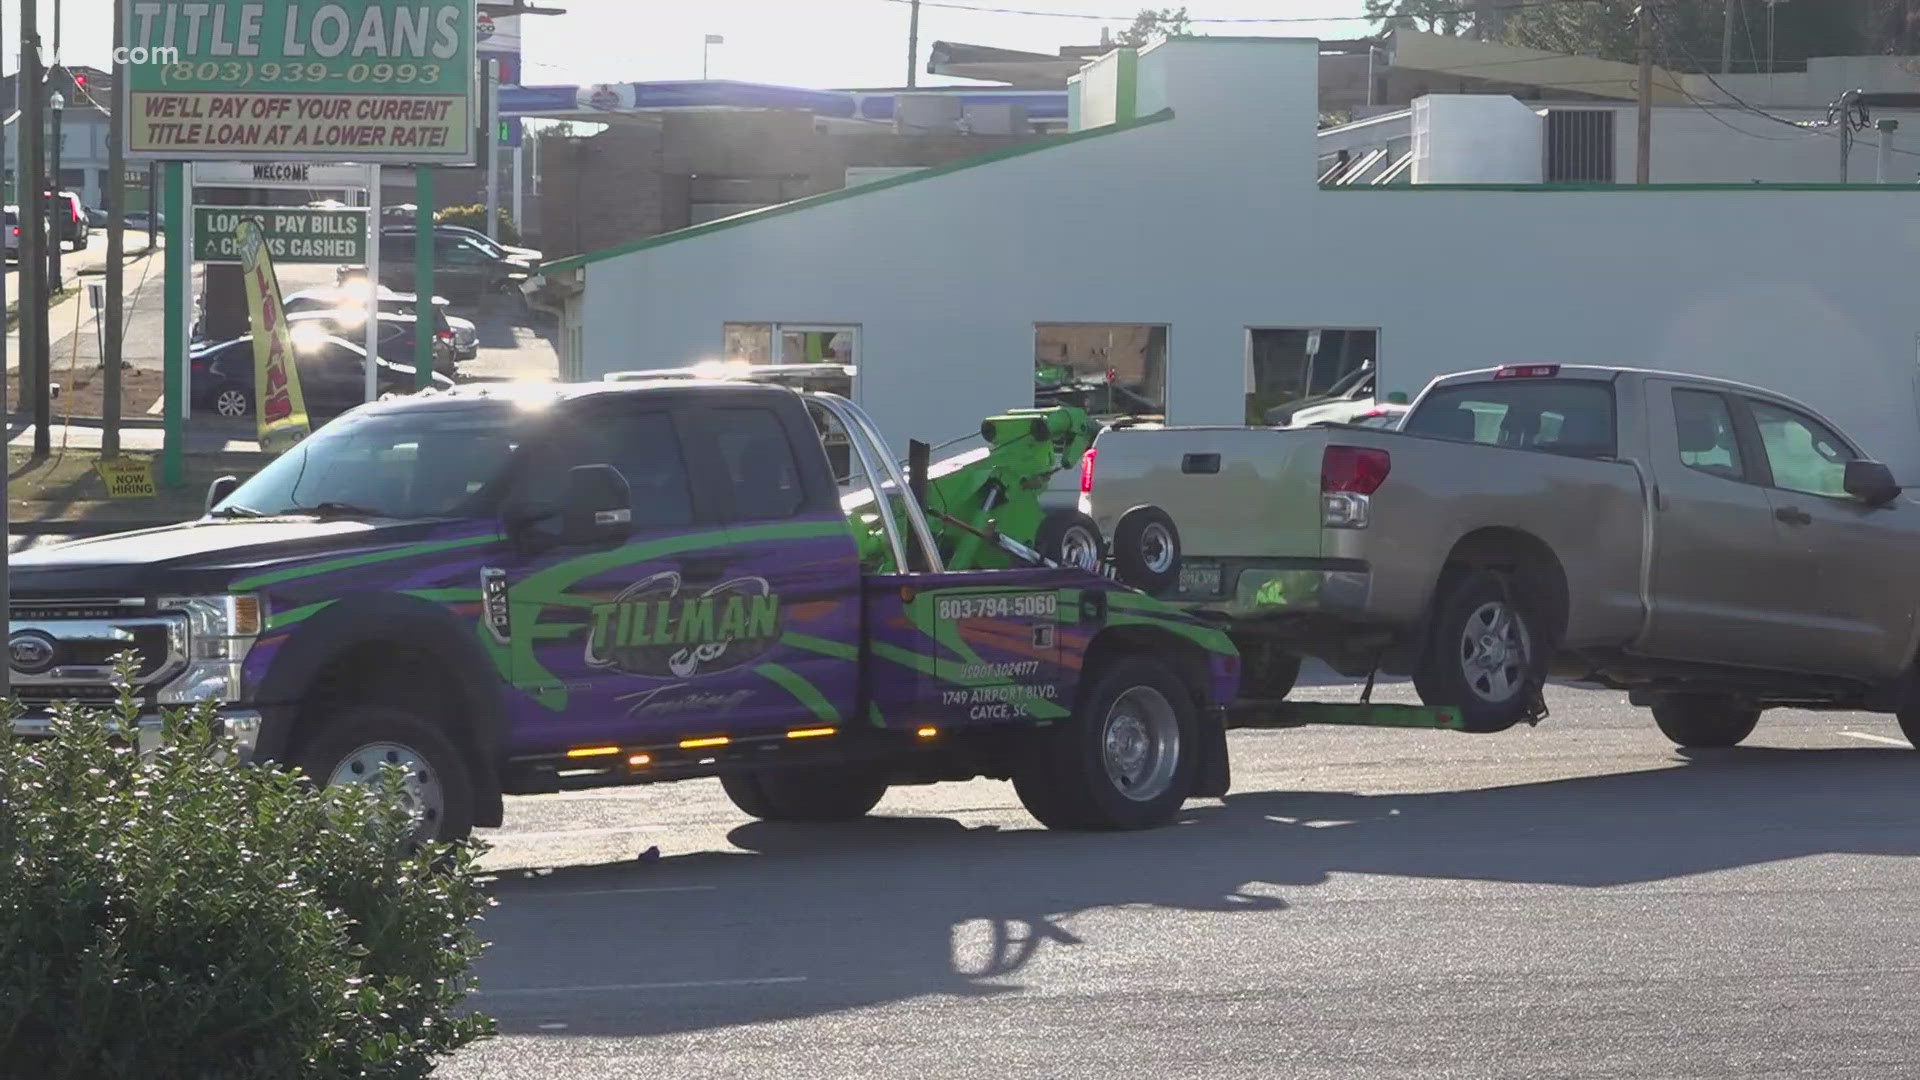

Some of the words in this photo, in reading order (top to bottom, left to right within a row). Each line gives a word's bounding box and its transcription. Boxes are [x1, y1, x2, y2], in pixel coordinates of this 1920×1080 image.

[134, 3, 264, 57] TITLE
[283, 4, 461, 59] LOANS
[145, 97, 203, 118] WE'LL
[208, 98, 248, 119] PAY
[251, 98, 291, 119] OFF
[297, 98, 352, 120] YOUR
[356, 99, 452, 121] CURRENT
[148, 123, 202, 144] TITLE
[205, 124, 261, 145] LOAN
[264, 124, 292, 145] AT
[293, 125, 308, 146] A
[312, 125, 386, 146] LOWER
[389, 126, 450, 147] RATE!
[253, 163, 309, 181] WELCOME
[207, 214, 265, 233] LOAS
[275, 215, 306, 233] PAY
[311, 216, 357, 234] BILLS
[290, 238, 356, 257] CASHED
[112, 484, 153, 494] HIRING
[115, 474, 145, 484] NOW
[939, 595, 1057, 620] 803-794-5060
[592, 593, 779, 649] TILLMAN
[994, 661, 1039, 677] 3024177
[942, 691, 969, 705] 1749
[970, 686, 1024, 703] AIRPORT
[1026, 684, 1059, 699] BLVD.
[970, 705, 1010, 720] CAYCE,
[1013, 704, 1028, 717] SC
